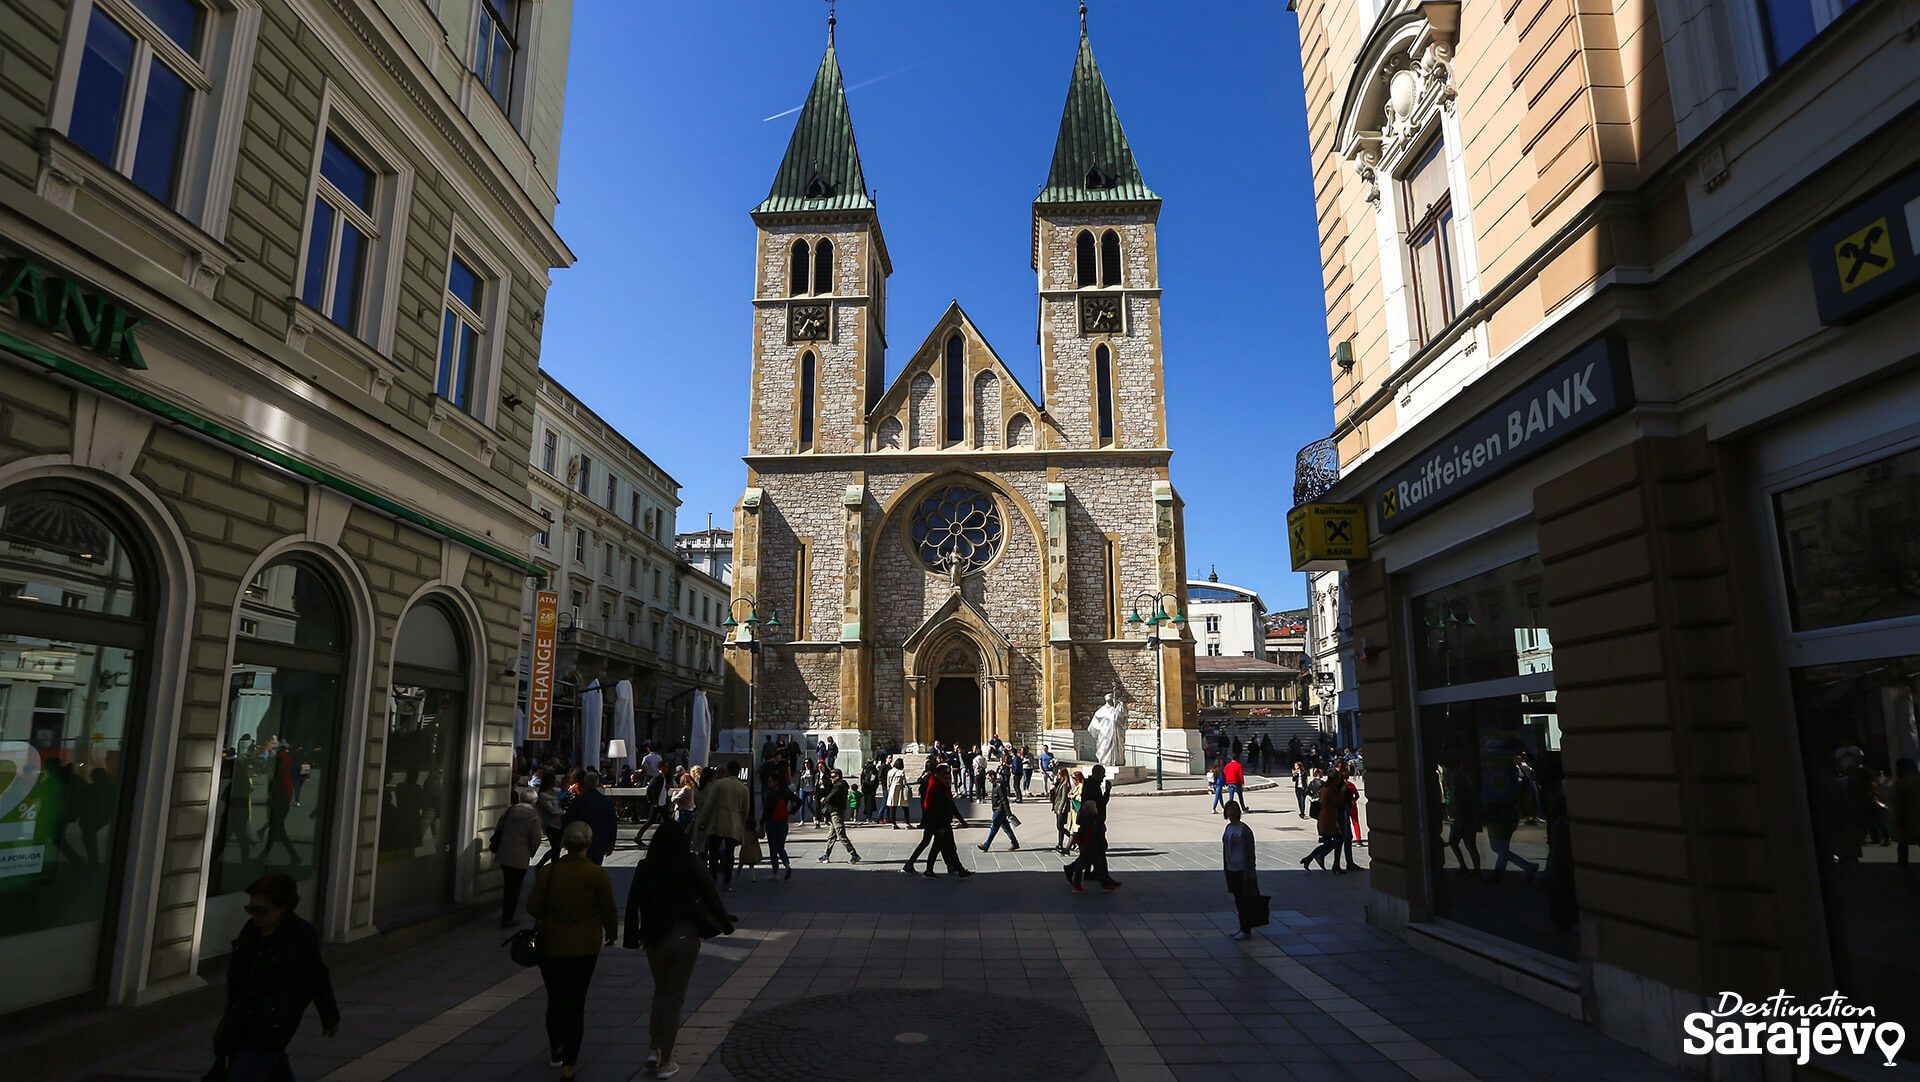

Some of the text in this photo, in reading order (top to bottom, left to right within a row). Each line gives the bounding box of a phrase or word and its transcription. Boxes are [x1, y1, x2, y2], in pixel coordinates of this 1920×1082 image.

[1398, 362, 1598, 510] Raiffeisen BANK
[539, 596, 557, 605] ATM
[532, 638, 552, 736] EXCHANGE
